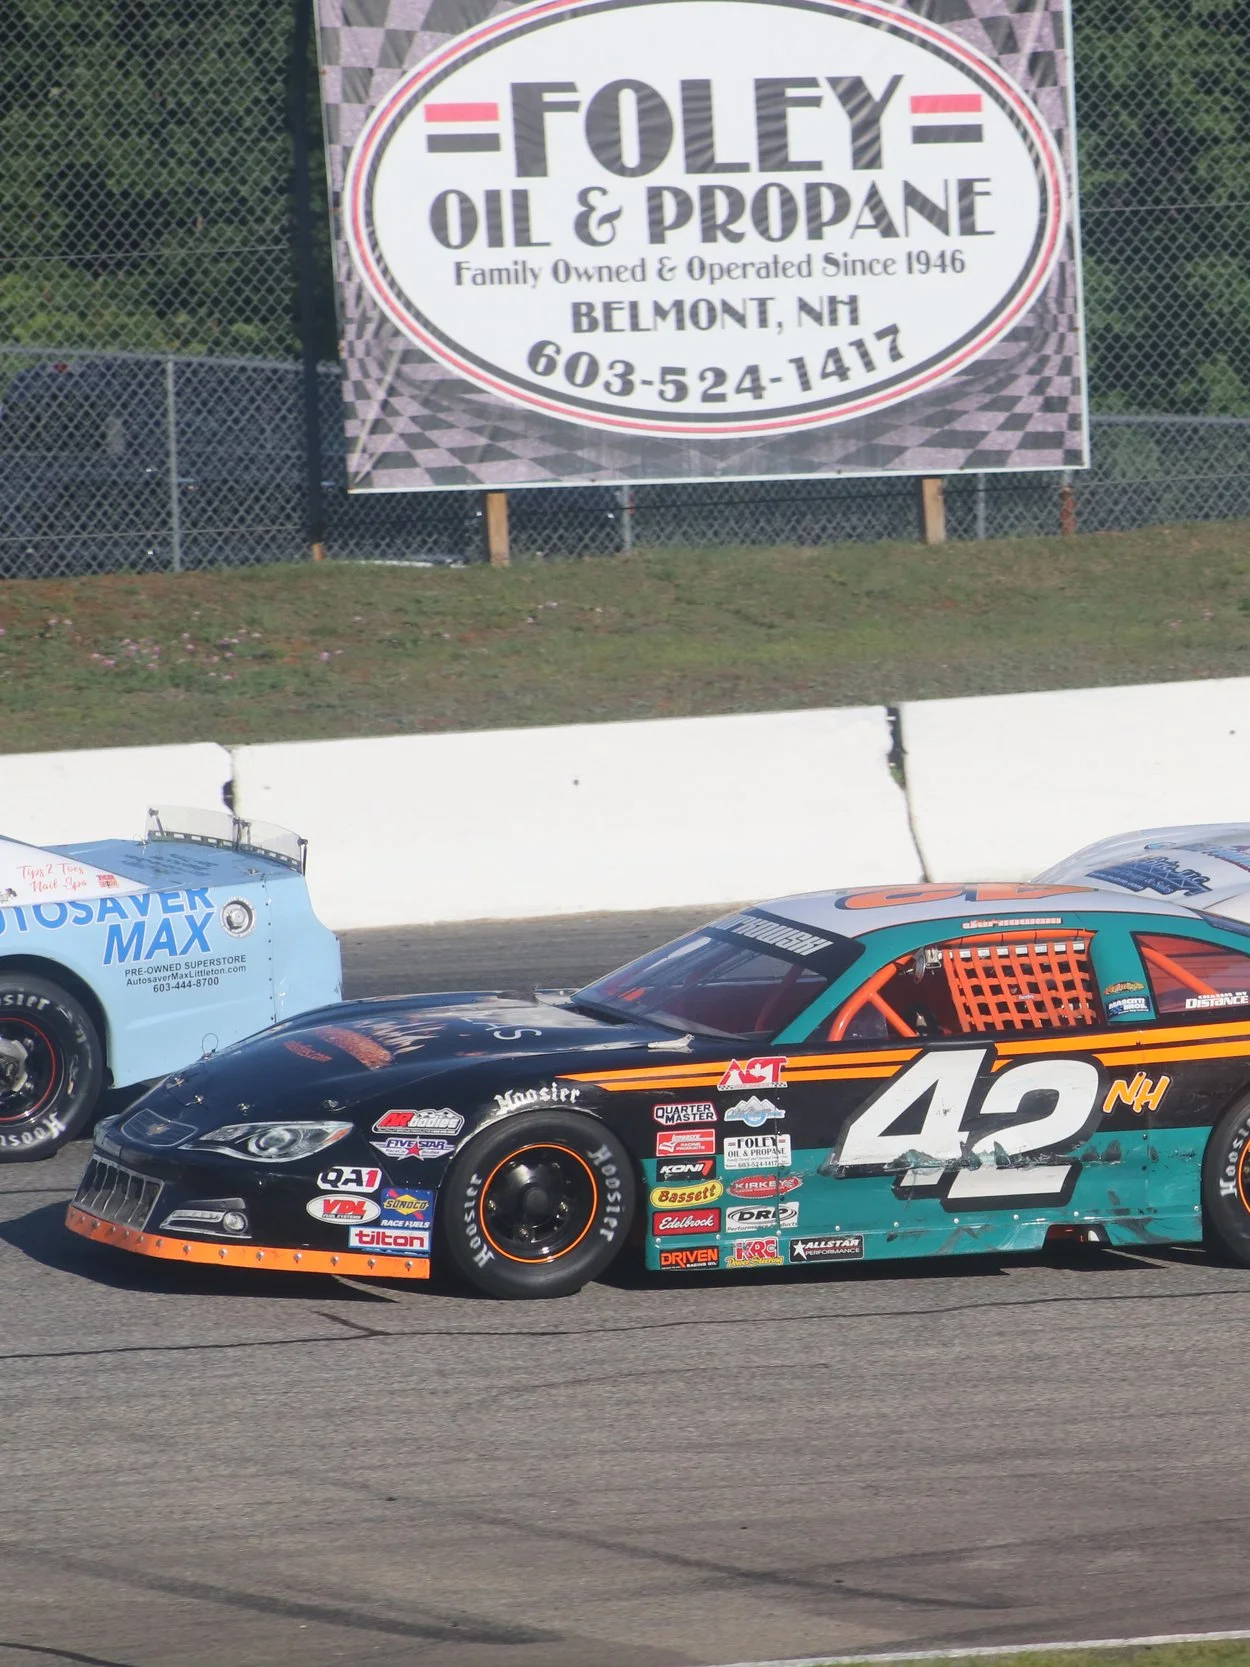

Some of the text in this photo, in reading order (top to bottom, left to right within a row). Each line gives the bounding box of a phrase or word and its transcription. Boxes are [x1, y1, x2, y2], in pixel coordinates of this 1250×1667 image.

[509, 74, 905, 178] FOLEY
[429, 177, 996, 249] OIL & PROPANE
[454, 250, 966, 289] Family Owned & Operated Since 1946
[571, 294, 859, 335] BELMONT, NH
[526, 324, 906, 403] 603-524-1417
[102, 911, 215, 967] MAX
[125, 955, 246, 977] PRE-OWNED SUPERSTORE
[126, 965, 246, 986] AutosaverMaxLittleton.com
[153, 977, 219, 993] 603-444-8700
[494, 1082, 581, 1115] Hoosier
[1102, 1072, 1170, 1113] NH
[656, 1104, 711, 1119] QUARTER
[665, 1112, 714, 1124] MASTER
[838, 1048, 1100, 1199] 42
[387, 1140, 445, 1149] FIVE STAR
[737, 1136, 777, 1148] FOLEY
[728, 1147, 786, 1157] OIL & PROPANE
[660, 1163, 703, 1174] KONI
[320, 1168, 379, 1189] QA1
[658, 1184, 716, 1203] Bassett
[323, 1199, 366, 1215] VDL
[385, 1200, 427, 1210] SUNOCO
[659, 1214, 715, 1230] Edelbrock
[355, 1230, 425, 1248] tilton
[805, 1239, 860, 1249] ALLSTAR
[661, 1249, 718, 1267] DRIVEN
[736, 1239, 777, 1259] KRC
